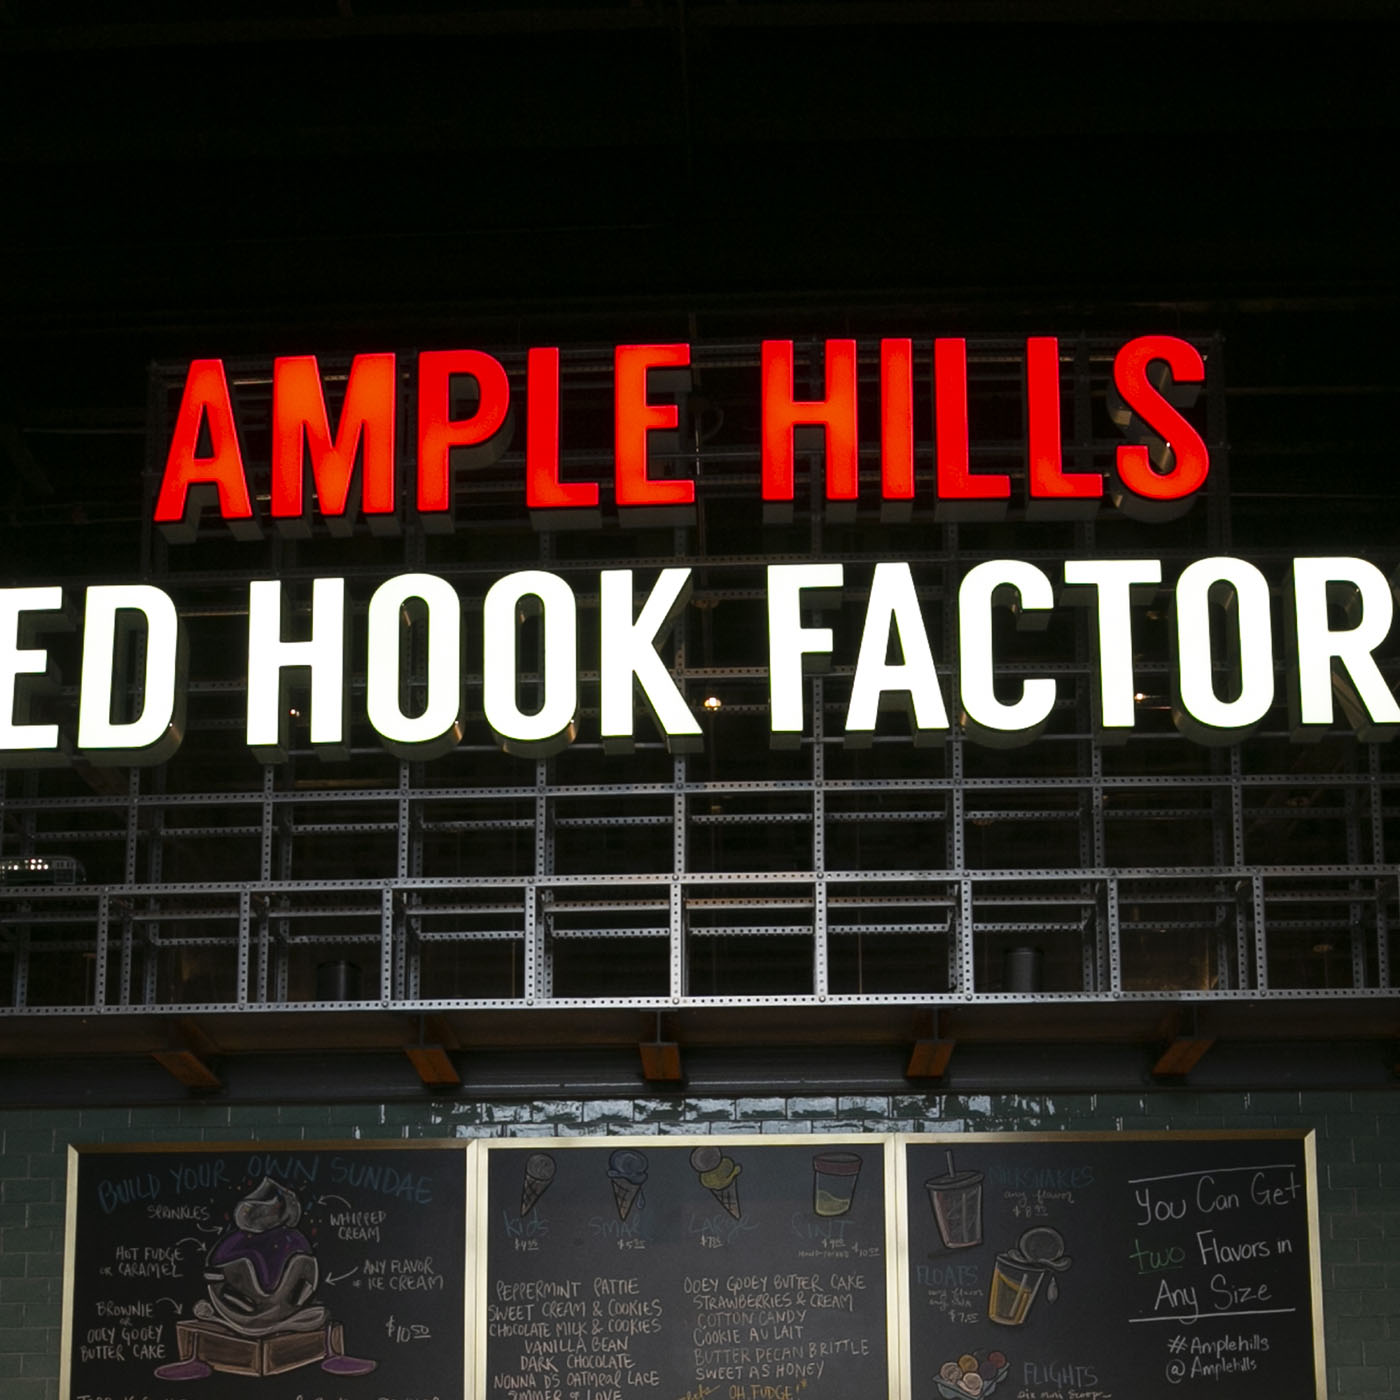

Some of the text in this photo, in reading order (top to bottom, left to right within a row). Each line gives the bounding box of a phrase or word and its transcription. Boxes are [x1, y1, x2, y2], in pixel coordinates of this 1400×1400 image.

[155, 336, 1210, 519] AMPLE HILLS
[248, 569, 704, 743] HOOK
[98, 1154, 432, 1214] BUILD YOUR OWN SUNDAE
[1135, 1171, 1300, 1226] You Can Get
[147, 1205, 210, 1221] SPRINKLES
[330, 1211, 387, 1227] WHIPPED
[338, 1226, 380, 1243] CREAM
[116, 1246, 184, 1264] HOT FUDGE
[1129, 1230, 1293, 1271] two Flavors in
[118, 1262, 184, 1278] CARAMEL
[364, 1256, 434, 1275] ANY FLAVOR
[916, 1264, 978, 1285] FLOATS
[368, 1274, 443, 1290] ICE CREAM
[496, 1276, 641, 1302] PEPPERMINT PATTIE
[683, 1272, 867, 1295] OOEY GOOEY BUTTER CAKE
[96, 1301, 153, 1318] BROWNIE
[692, 1292, 792, 1311] STRAWBERRIES
[810, 1293, 855, 1313] CREAM
[1154, 1273, 1272, 1325] Any Size
[487, 1298, 664, 1322] SWEET CREAM & COOKIES
[697, 1310, 807, 1329] COTTON CANDY
[122, 1325, 163, 1346] GOOEY
[488, 1318, 663, 1339] CHOCOLATE MILK & COOKIES
[693, 1325, 804, 1347] COOKIE AU LAIT
[81, 1344, 166, 1362] BUTTER CAKE
[524, 1335, 629, 1356] VANILLA BEAN
[693, 1338, 870, 1367] BUTTER PECAN BRITTLE
[520, 1353, 636, 1373] DARK CHOCOLATE
[696, 1360, 825, 1381] SWEET AS HONEY
[494, 1374, 537, 1390] NONNA
[627, 1370, 661, 1387] LACE
[1024, 1361, 1098, 1388] FLIGHTS
